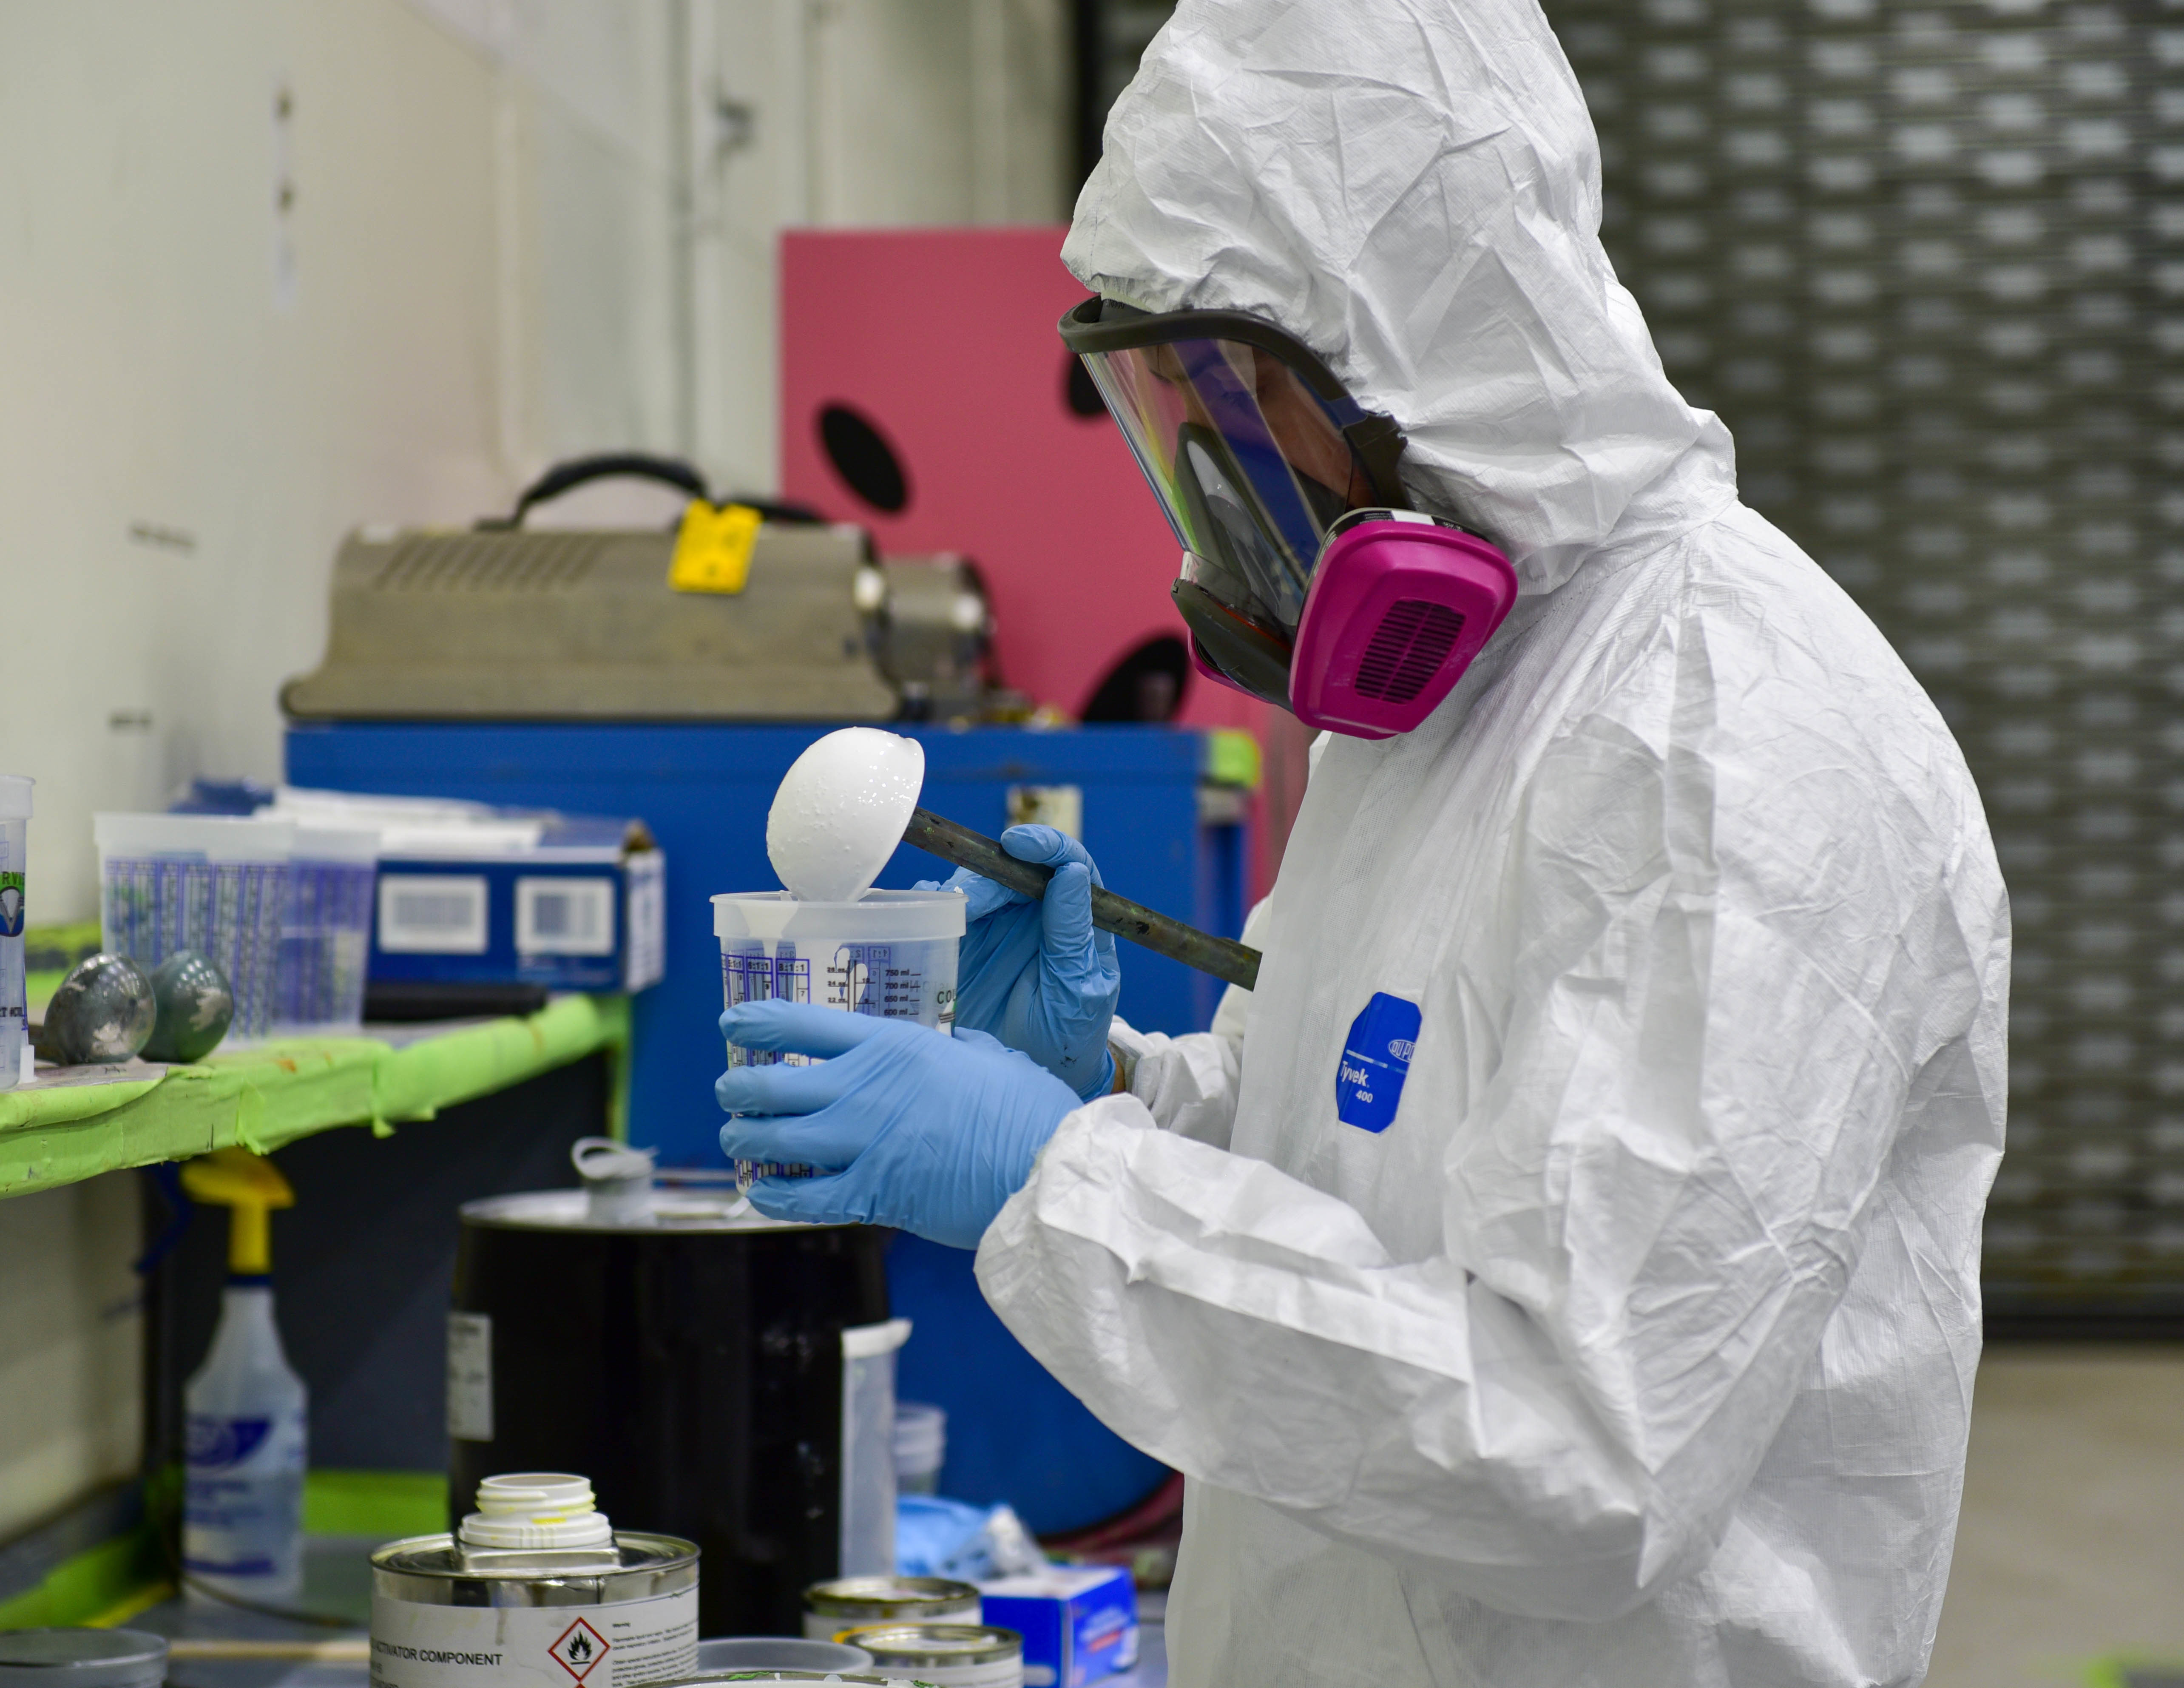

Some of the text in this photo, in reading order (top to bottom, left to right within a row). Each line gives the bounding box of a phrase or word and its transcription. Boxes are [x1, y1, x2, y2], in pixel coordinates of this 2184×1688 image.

[778, 963, 805, 972] 8:1:1
[1339, 1060, 1369, 1087] Tyvek
[1355, 1090, 1373, 1103] 400
[419, 1649, 503, 1666] COMPONENT
